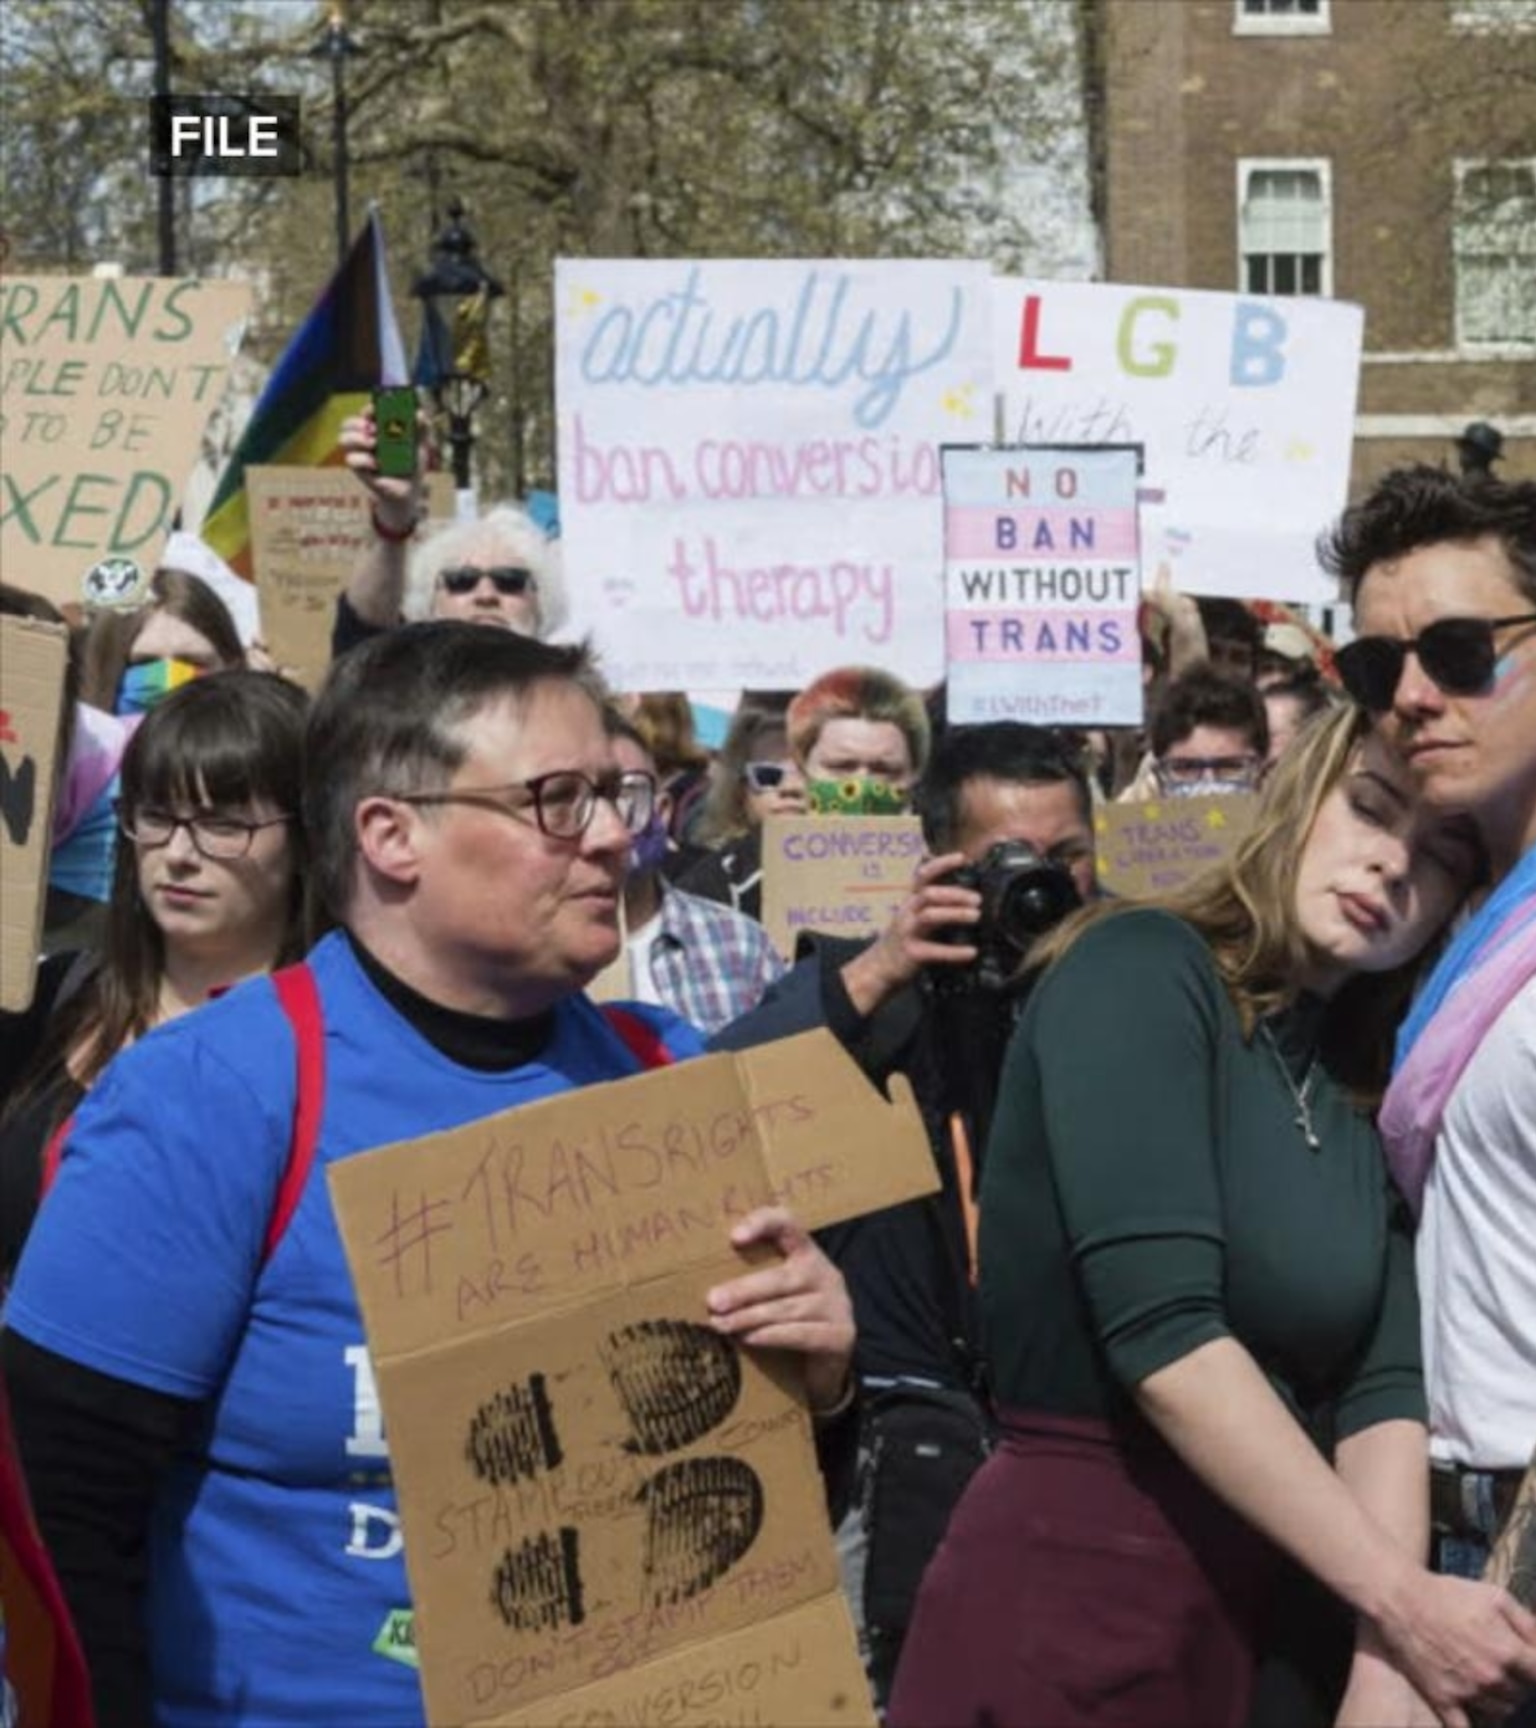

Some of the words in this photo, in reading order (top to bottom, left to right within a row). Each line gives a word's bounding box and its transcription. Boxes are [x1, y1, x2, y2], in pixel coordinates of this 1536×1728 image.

[0, 277, 202, 346] RANS
[581, 265, 962, 429] actually
[21, 410, 67, 443] TO
[89, 408, 161, 452] BE
[572, 412, 687, 504] ban
[1182, 402, 1261, 464] the
[1005, 467, 1077, 499] NO
[995, 517, 1096, 550] BAN
[669, 536, 895, 644] therapy
[961, 568, 1132, 601] WITHOUT
[970, 619, 1122, 653] TRANS
[1121, 821, 1201, 846] TRANS
[456, 1253, 544, 1321] ARE
[573, 1206, 715, 1271] HUMAN
[432, 1468, 570, 1560] STAMP
